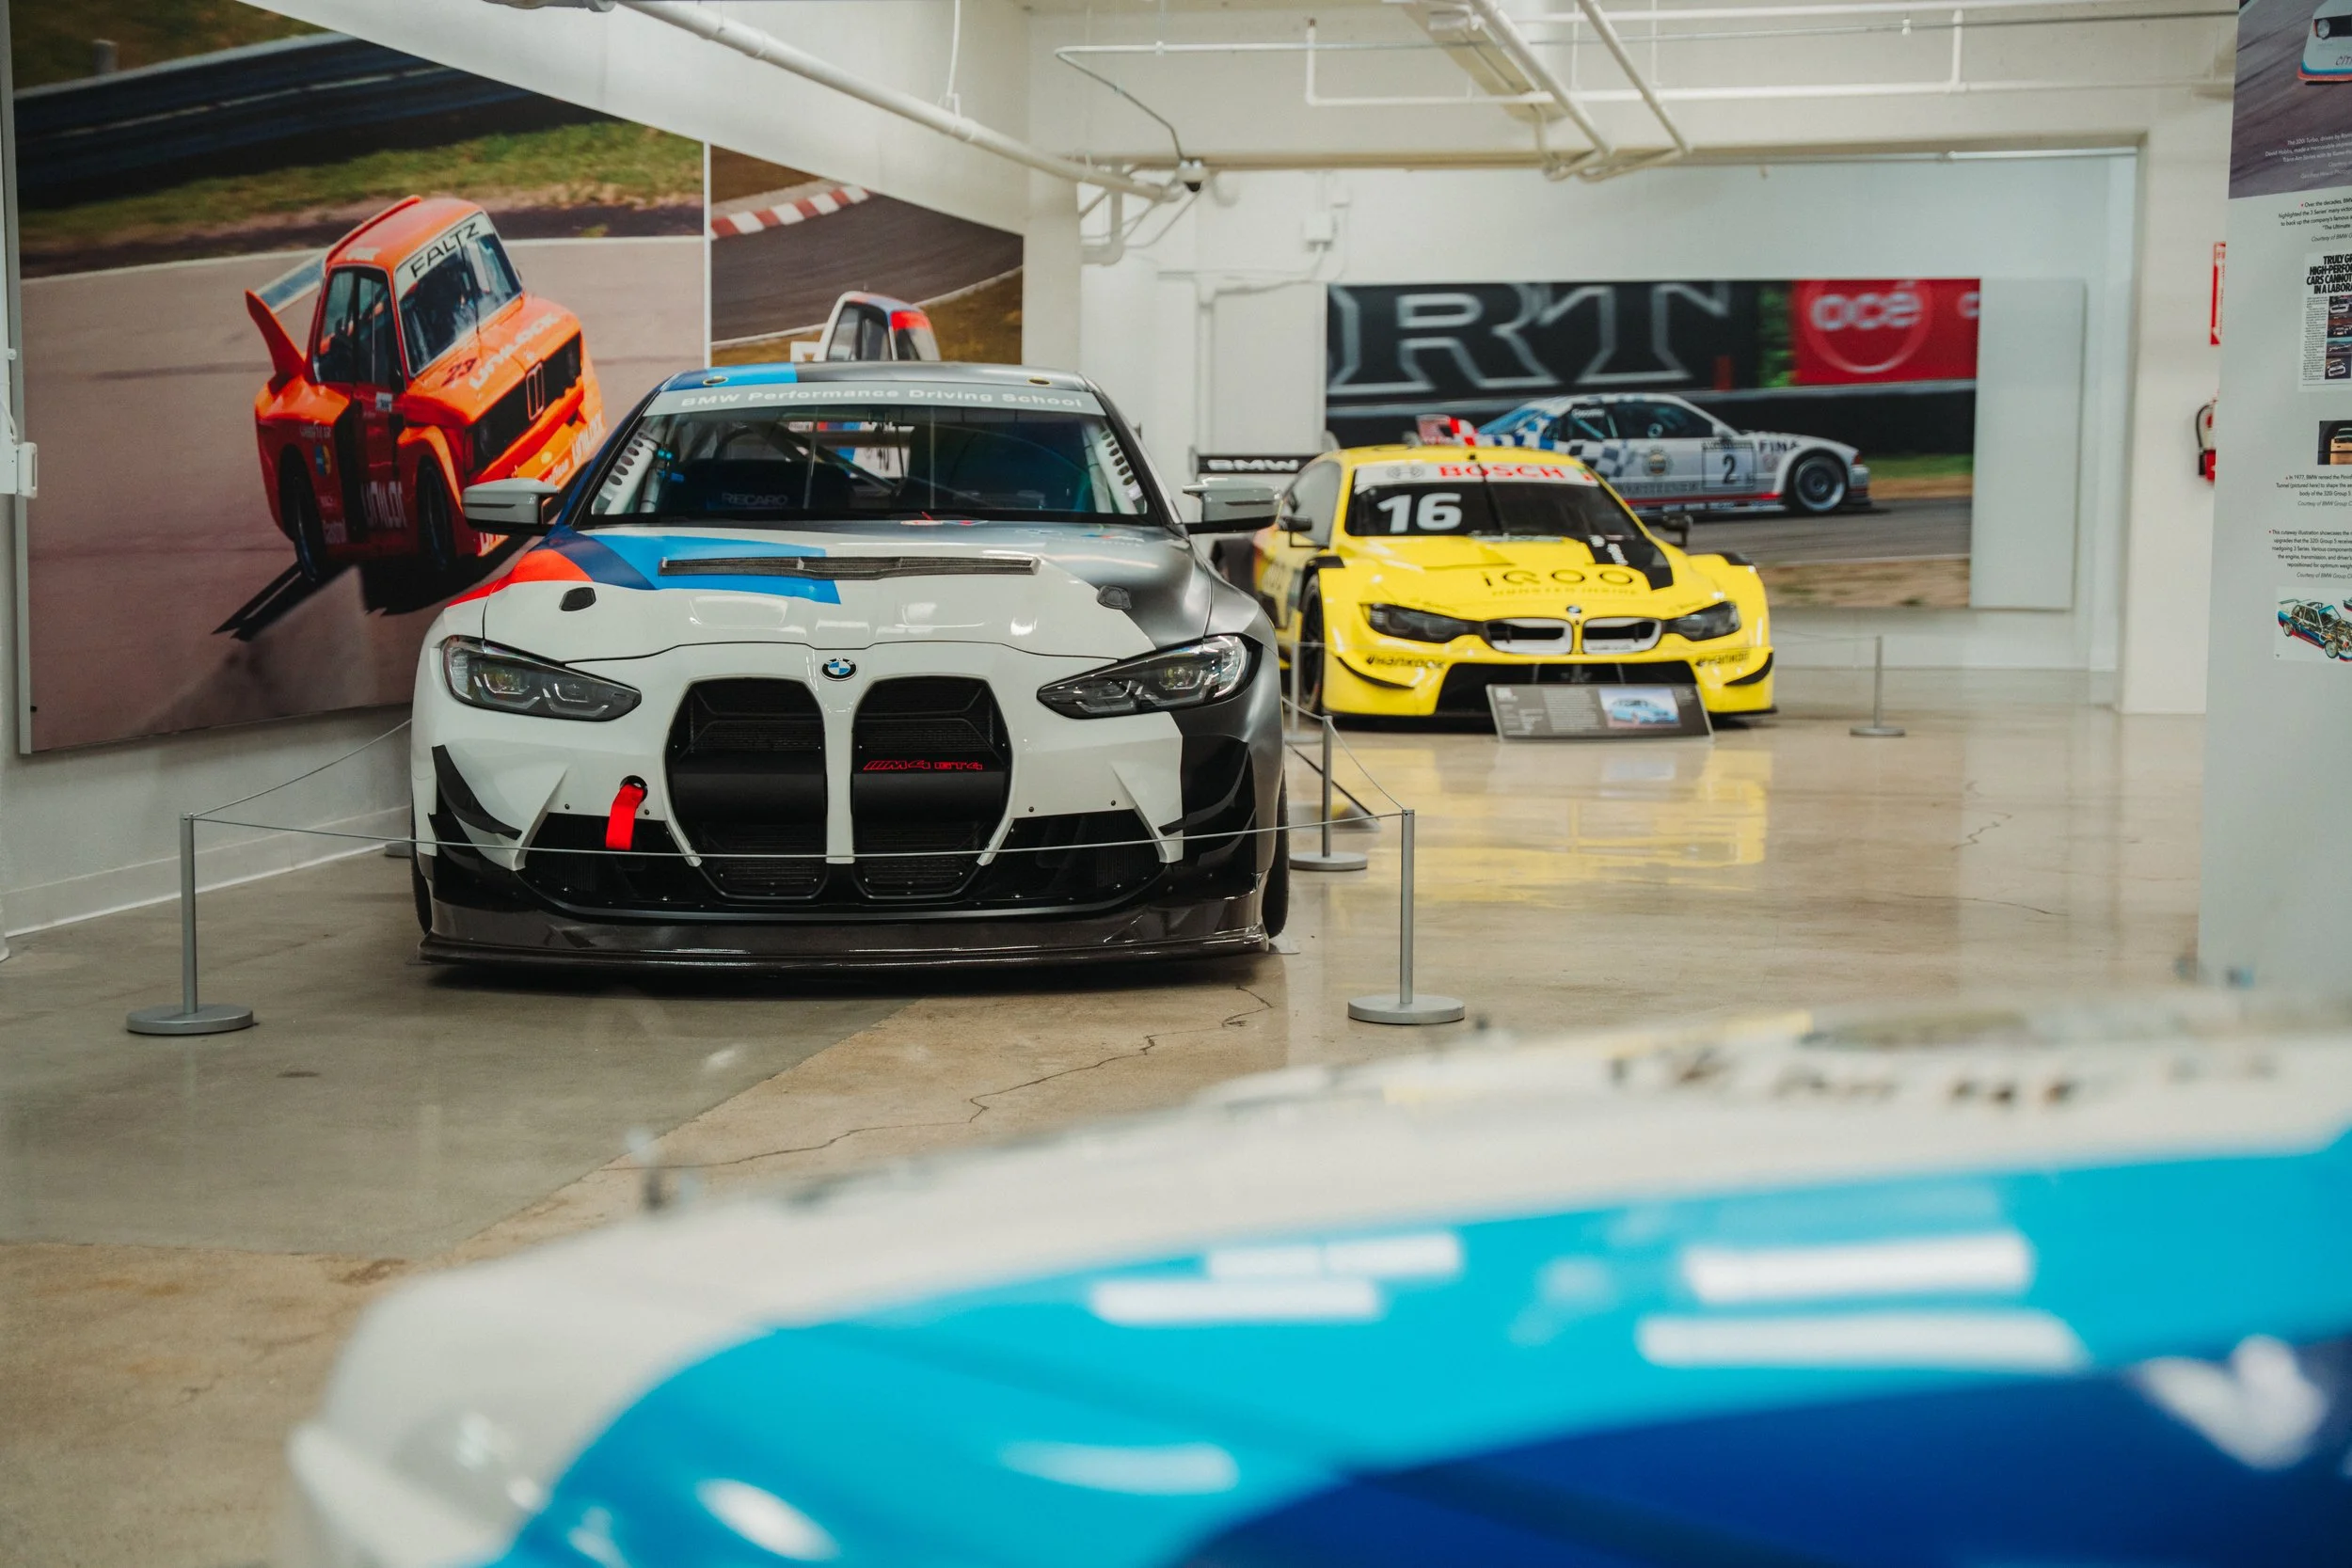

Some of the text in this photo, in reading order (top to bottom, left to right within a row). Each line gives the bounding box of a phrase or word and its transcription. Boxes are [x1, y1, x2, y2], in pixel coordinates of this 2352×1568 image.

[410, 222, 479, 278] FALTZ
[2323, 255, 2344, 265] TRULY
[2310, 264, 2352, 276] HIGH-PERFO
[2306, 273, 2352, 285] CARS CANNOT
[681, 389, 1082, 408] BMW Performance Driving School
[1207, 459, 1298, 471] BMW
[1438, 464, 1565, 479] BOSCH
[1723, 453, 1737, 484] 2
[721, 492, 787, 506] RECARO
[1376, 492, 1463, 533] 16
[934, 761, 983, 770] GT4
